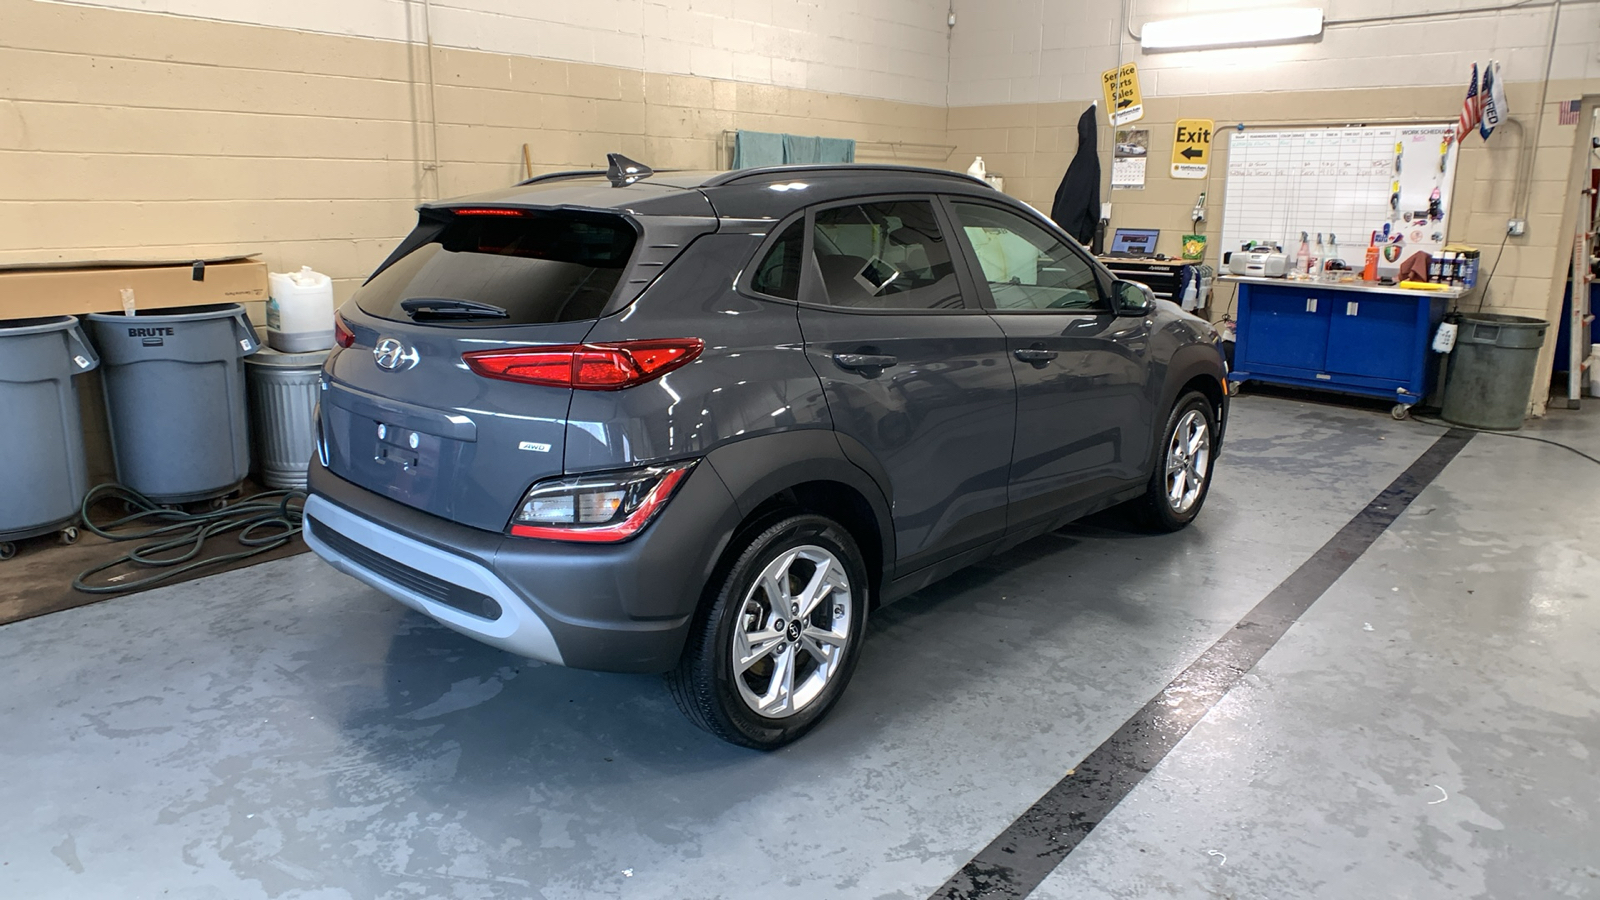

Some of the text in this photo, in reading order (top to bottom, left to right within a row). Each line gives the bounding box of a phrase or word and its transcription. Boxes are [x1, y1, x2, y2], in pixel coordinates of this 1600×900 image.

[1104, 68, 1135, 83] Service
[1110, 79, 1132, 91] Parts
[1112, 88, 1133, 101] Sales
[1176, 126, 1211, 144] Exit
[128, 327, 174, 337] BRUTE
[523, 443, 546, 451] AWD
